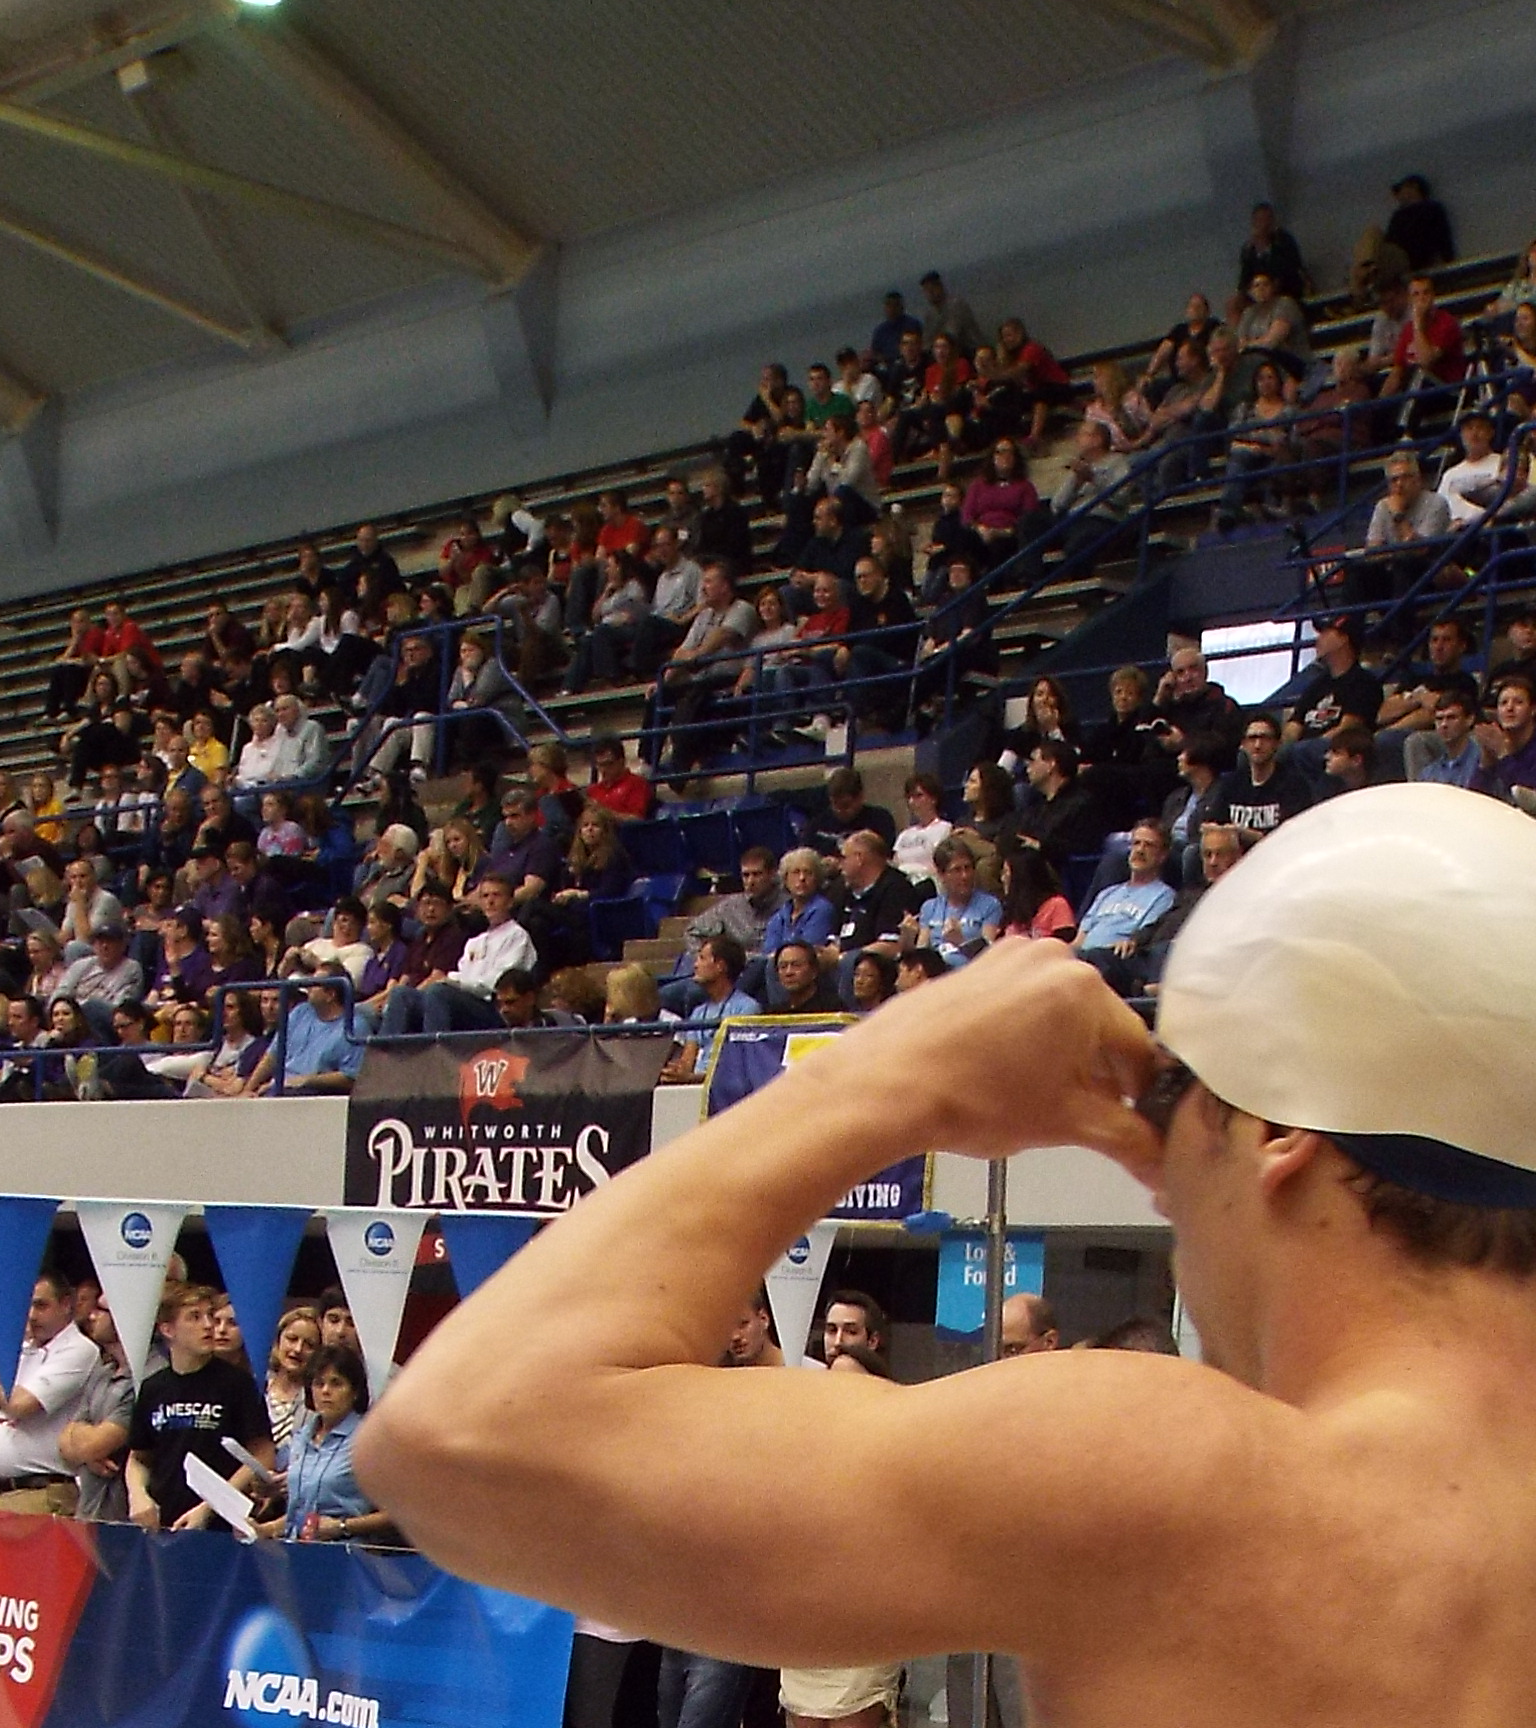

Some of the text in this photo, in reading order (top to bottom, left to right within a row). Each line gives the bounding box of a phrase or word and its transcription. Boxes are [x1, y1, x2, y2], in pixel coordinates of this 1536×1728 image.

[473, 1058, 509, 1098] W
[423, 1123, 563, 1140] WHITWORTH
[367, 1118, 610, 1211] PIRATES
[964, 1265, 1017, 1287] Fod
[166, 1402, 223, 1418] NESCAC
